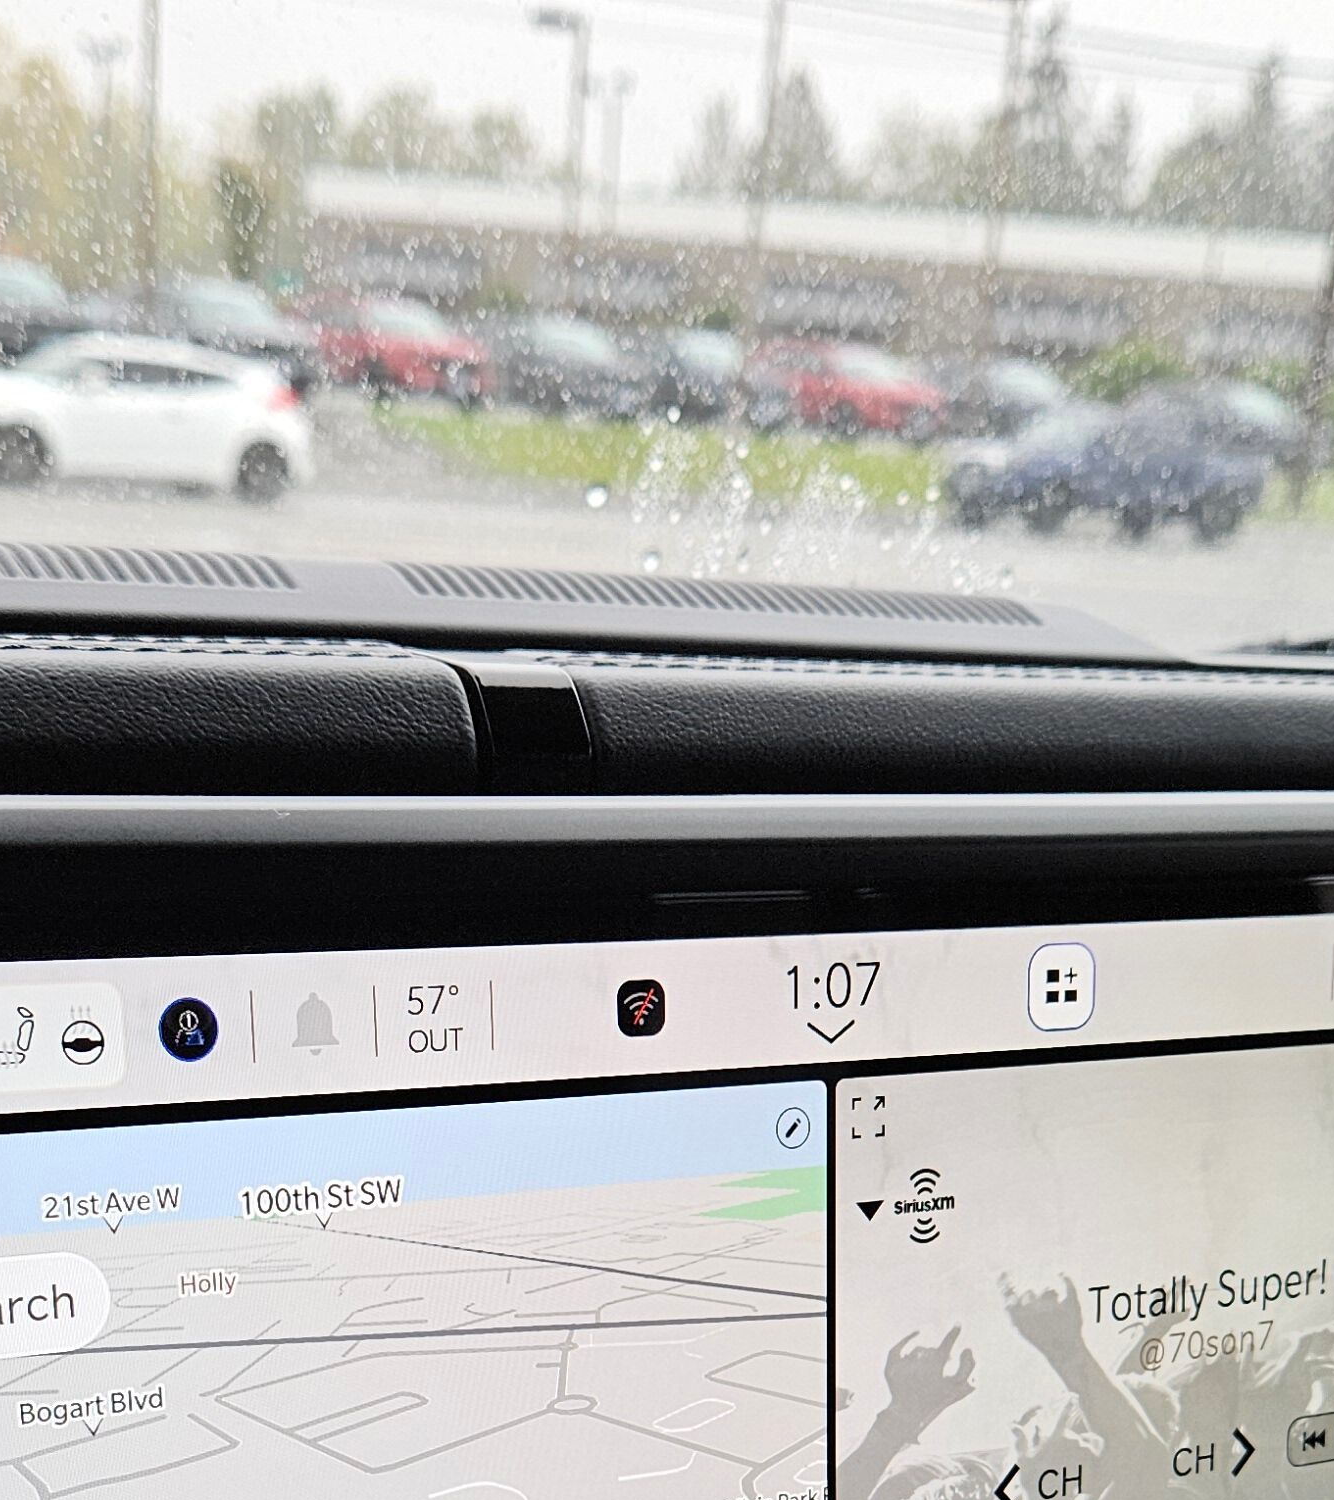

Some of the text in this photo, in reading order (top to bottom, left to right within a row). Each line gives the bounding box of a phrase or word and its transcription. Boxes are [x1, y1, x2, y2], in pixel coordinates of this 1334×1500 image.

[786, 961, 881, 1011] 1:07
[408, 1027, 463, 1054] OUT
[43, 1187, 180, 1219] 21st Ave W
[241, 1179, 401, 1215] 100th St SW
[180, 1272, 236, 1295] Holly
[1088, 1258, 1327, 1323] Totally Super!
[1139, 1320, 1274, 1371] @70son7
[19, 1387, 164, 1425] Bogart Blvd
[1172, 1443, 1216, 1477] CH
[1038, 1464, 1084, 1500] CH
